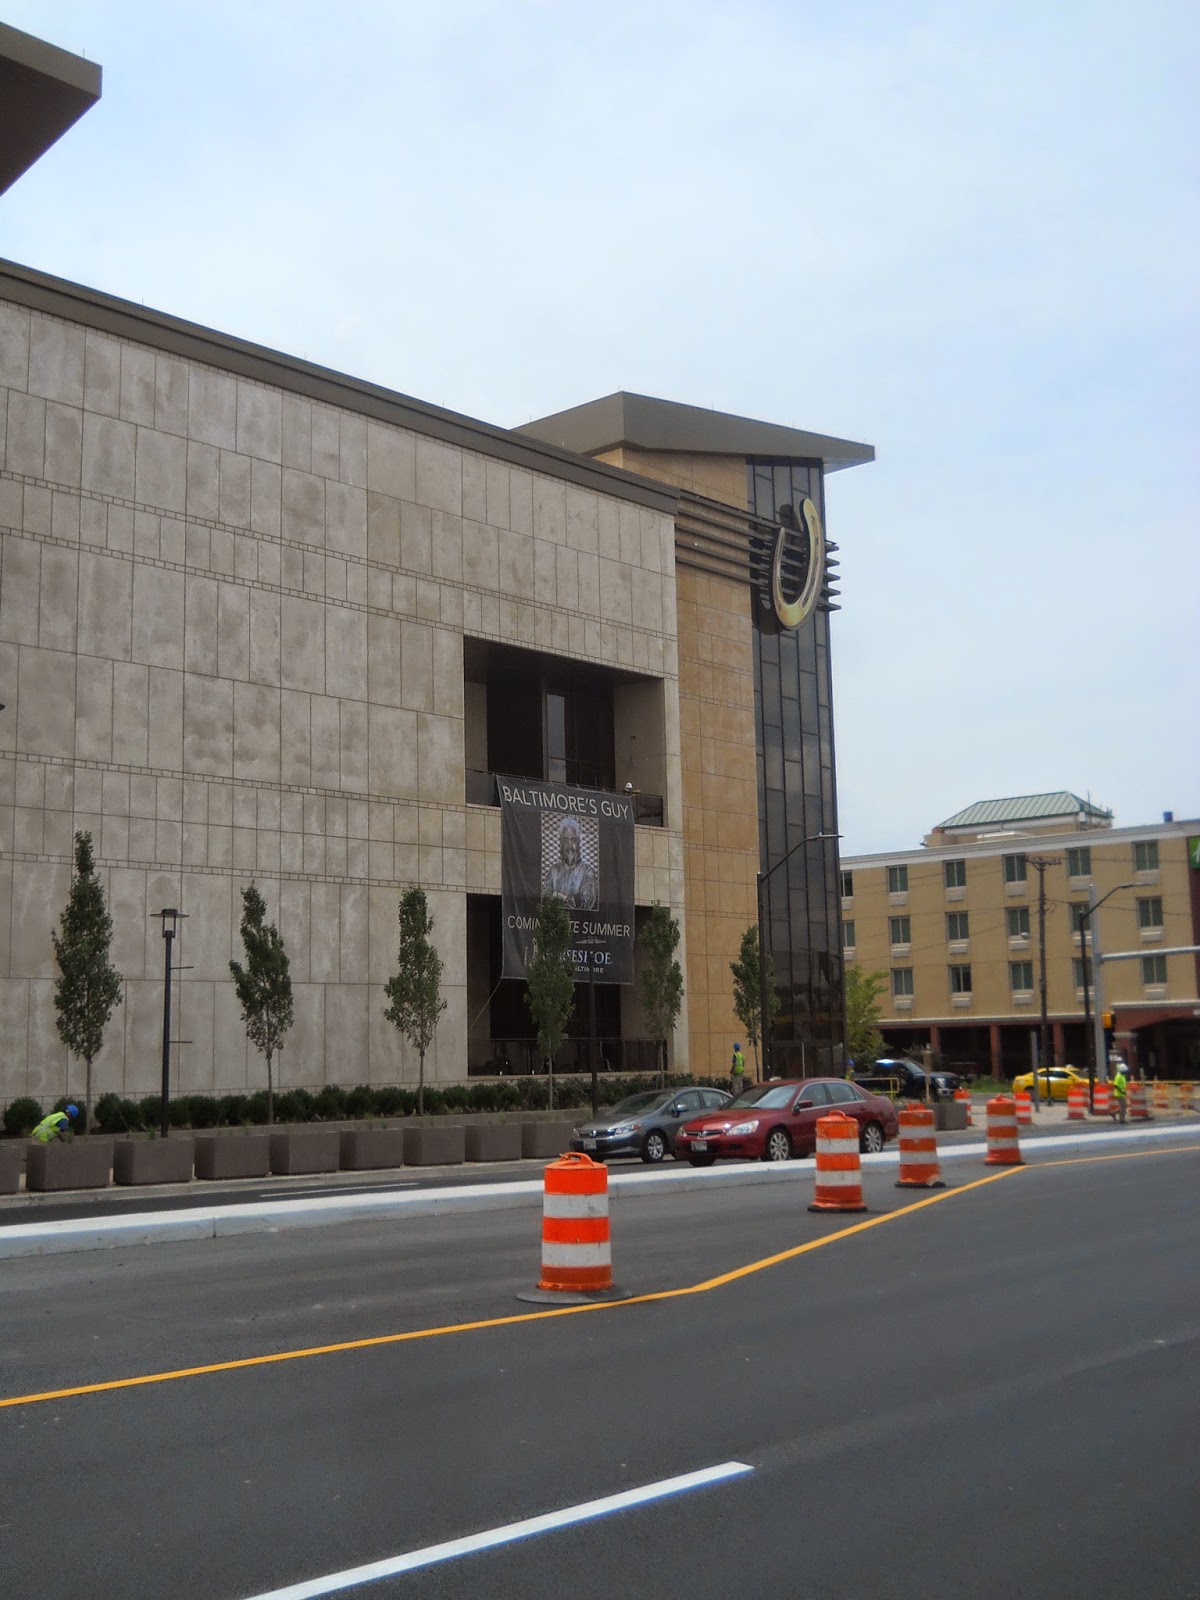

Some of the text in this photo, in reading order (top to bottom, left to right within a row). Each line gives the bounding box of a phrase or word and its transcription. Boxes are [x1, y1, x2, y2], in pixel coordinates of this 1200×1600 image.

[502, 786, 628, 819] BALTIMORE'S GUY
[507, 915, 545, 931] COMIN
[582, 921, 630, 937] SUMMER
